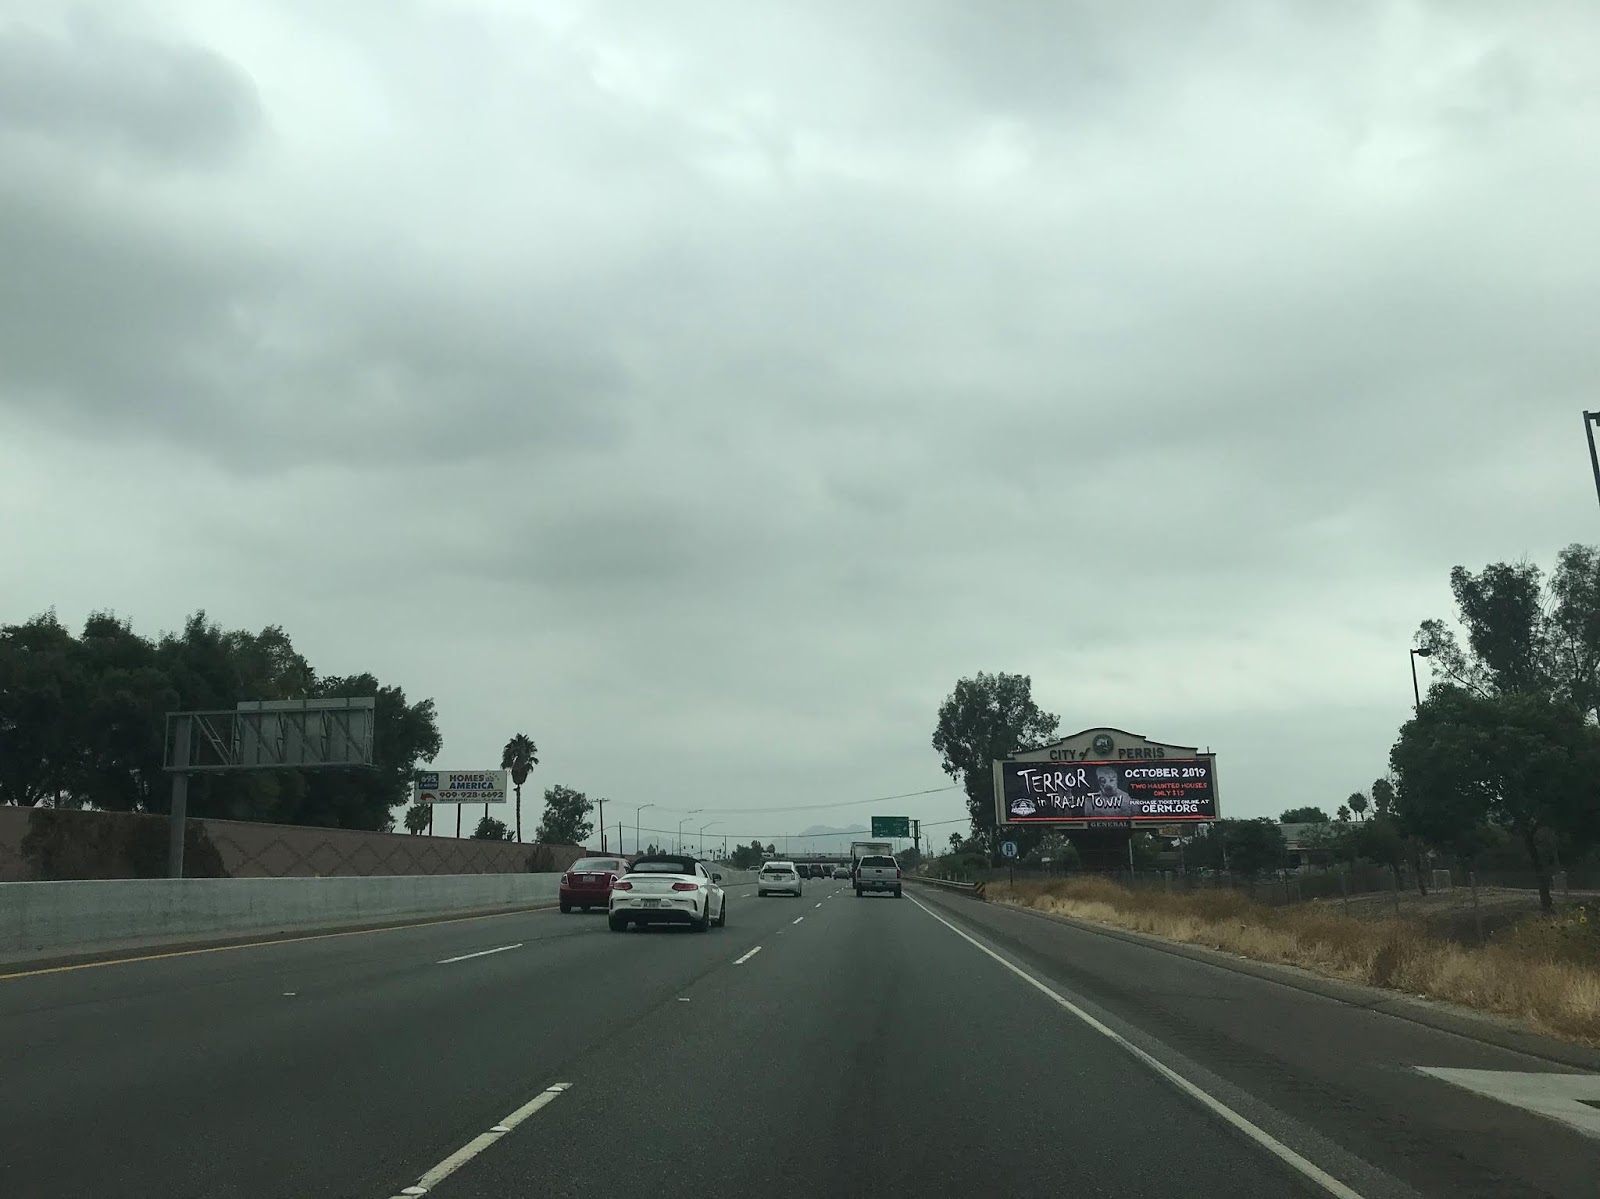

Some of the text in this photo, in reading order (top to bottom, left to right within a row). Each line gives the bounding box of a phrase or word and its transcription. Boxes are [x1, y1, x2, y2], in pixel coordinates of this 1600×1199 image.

[1049, 747, 1165, 761] CITY of PERRIS
[449, 774, 484, 782] HOMES
[1124, 767, 1206, 778] OCTOBER 2019
[449, 782, 494, 790] AMERICA
[1017, 768, 1090, 794] TERROR
[1037, 792, 1123, 809] in TRAIN TOWN
[1142, 804, 1198, 813] OERM.ORG
